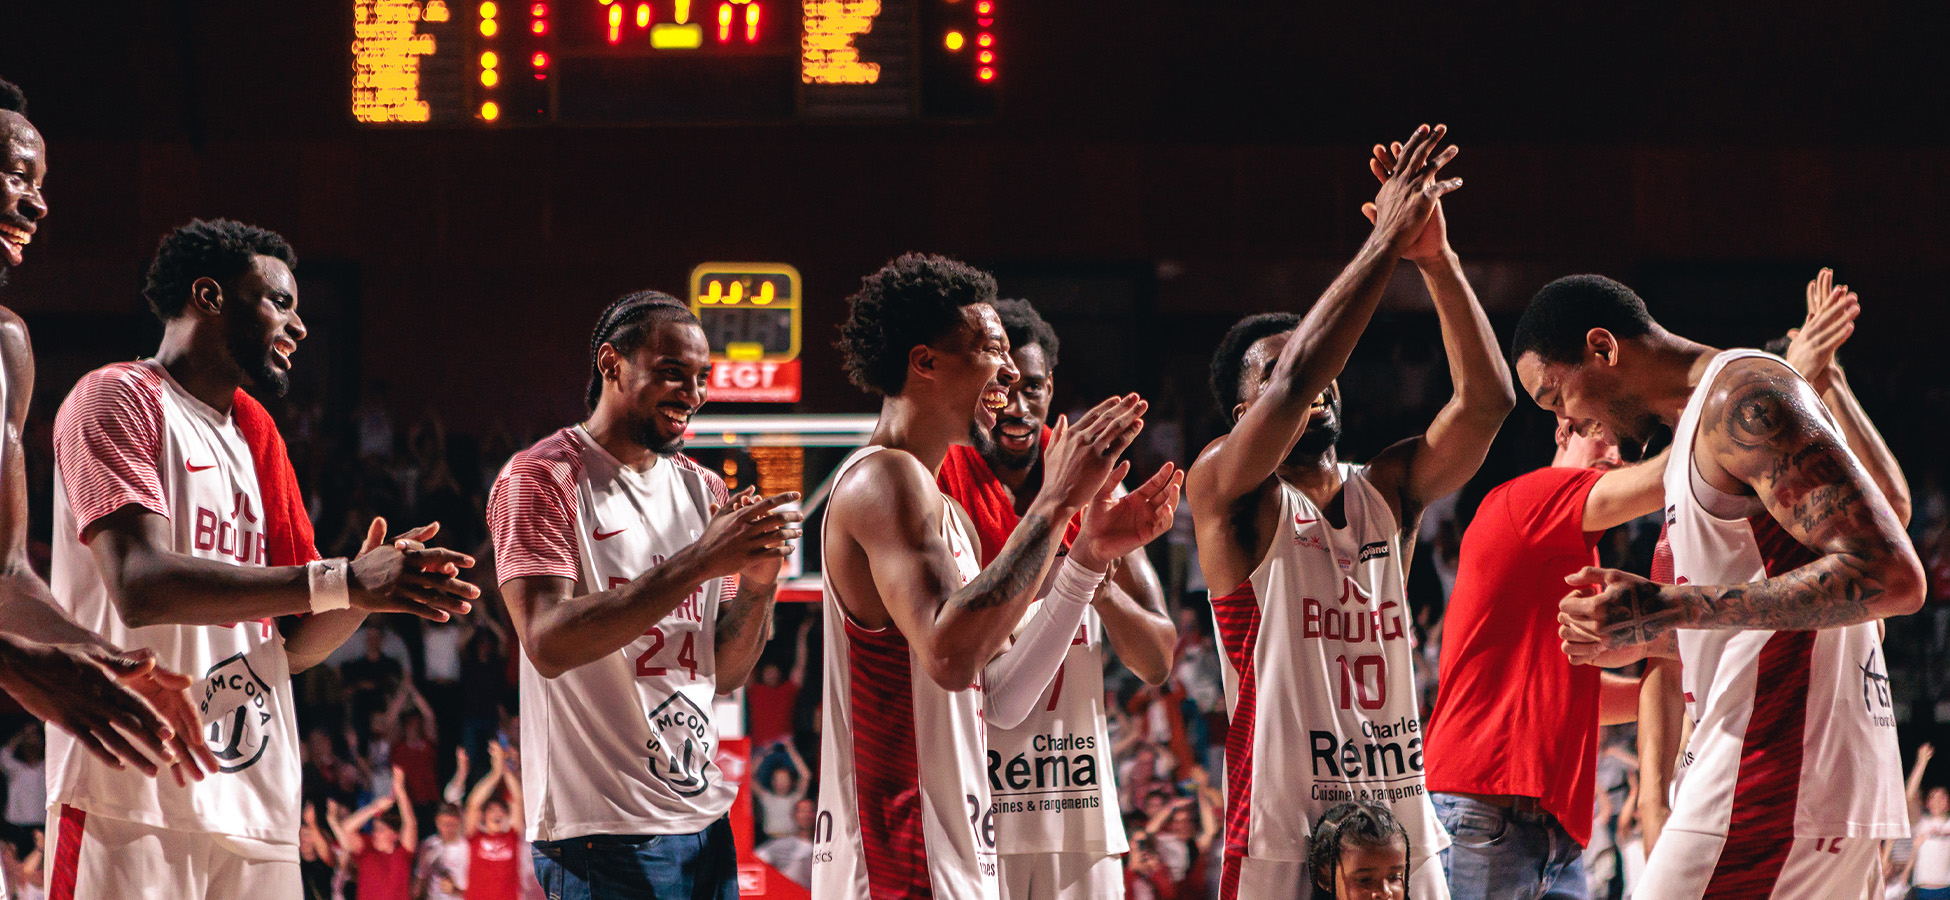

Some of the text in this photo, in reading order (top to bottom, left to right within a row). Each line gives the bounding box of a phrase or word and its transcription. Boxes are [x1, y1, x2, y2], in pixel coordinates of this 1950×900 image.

[636, 626, 698, 681] 24
[201, 674, 271, 727] SEMCODA
[1336, 655, 1386, 710] 10
[646, 711, 710, 755] SEMCODA
[1033, 733, 1095, 752] Charles
[1362, 716, 1420, 740] Charle
[987, 749, 1098, 790] Réma
[1309, 730, 1425, 778] Réma
[1027, 799, 1036, 812] &
